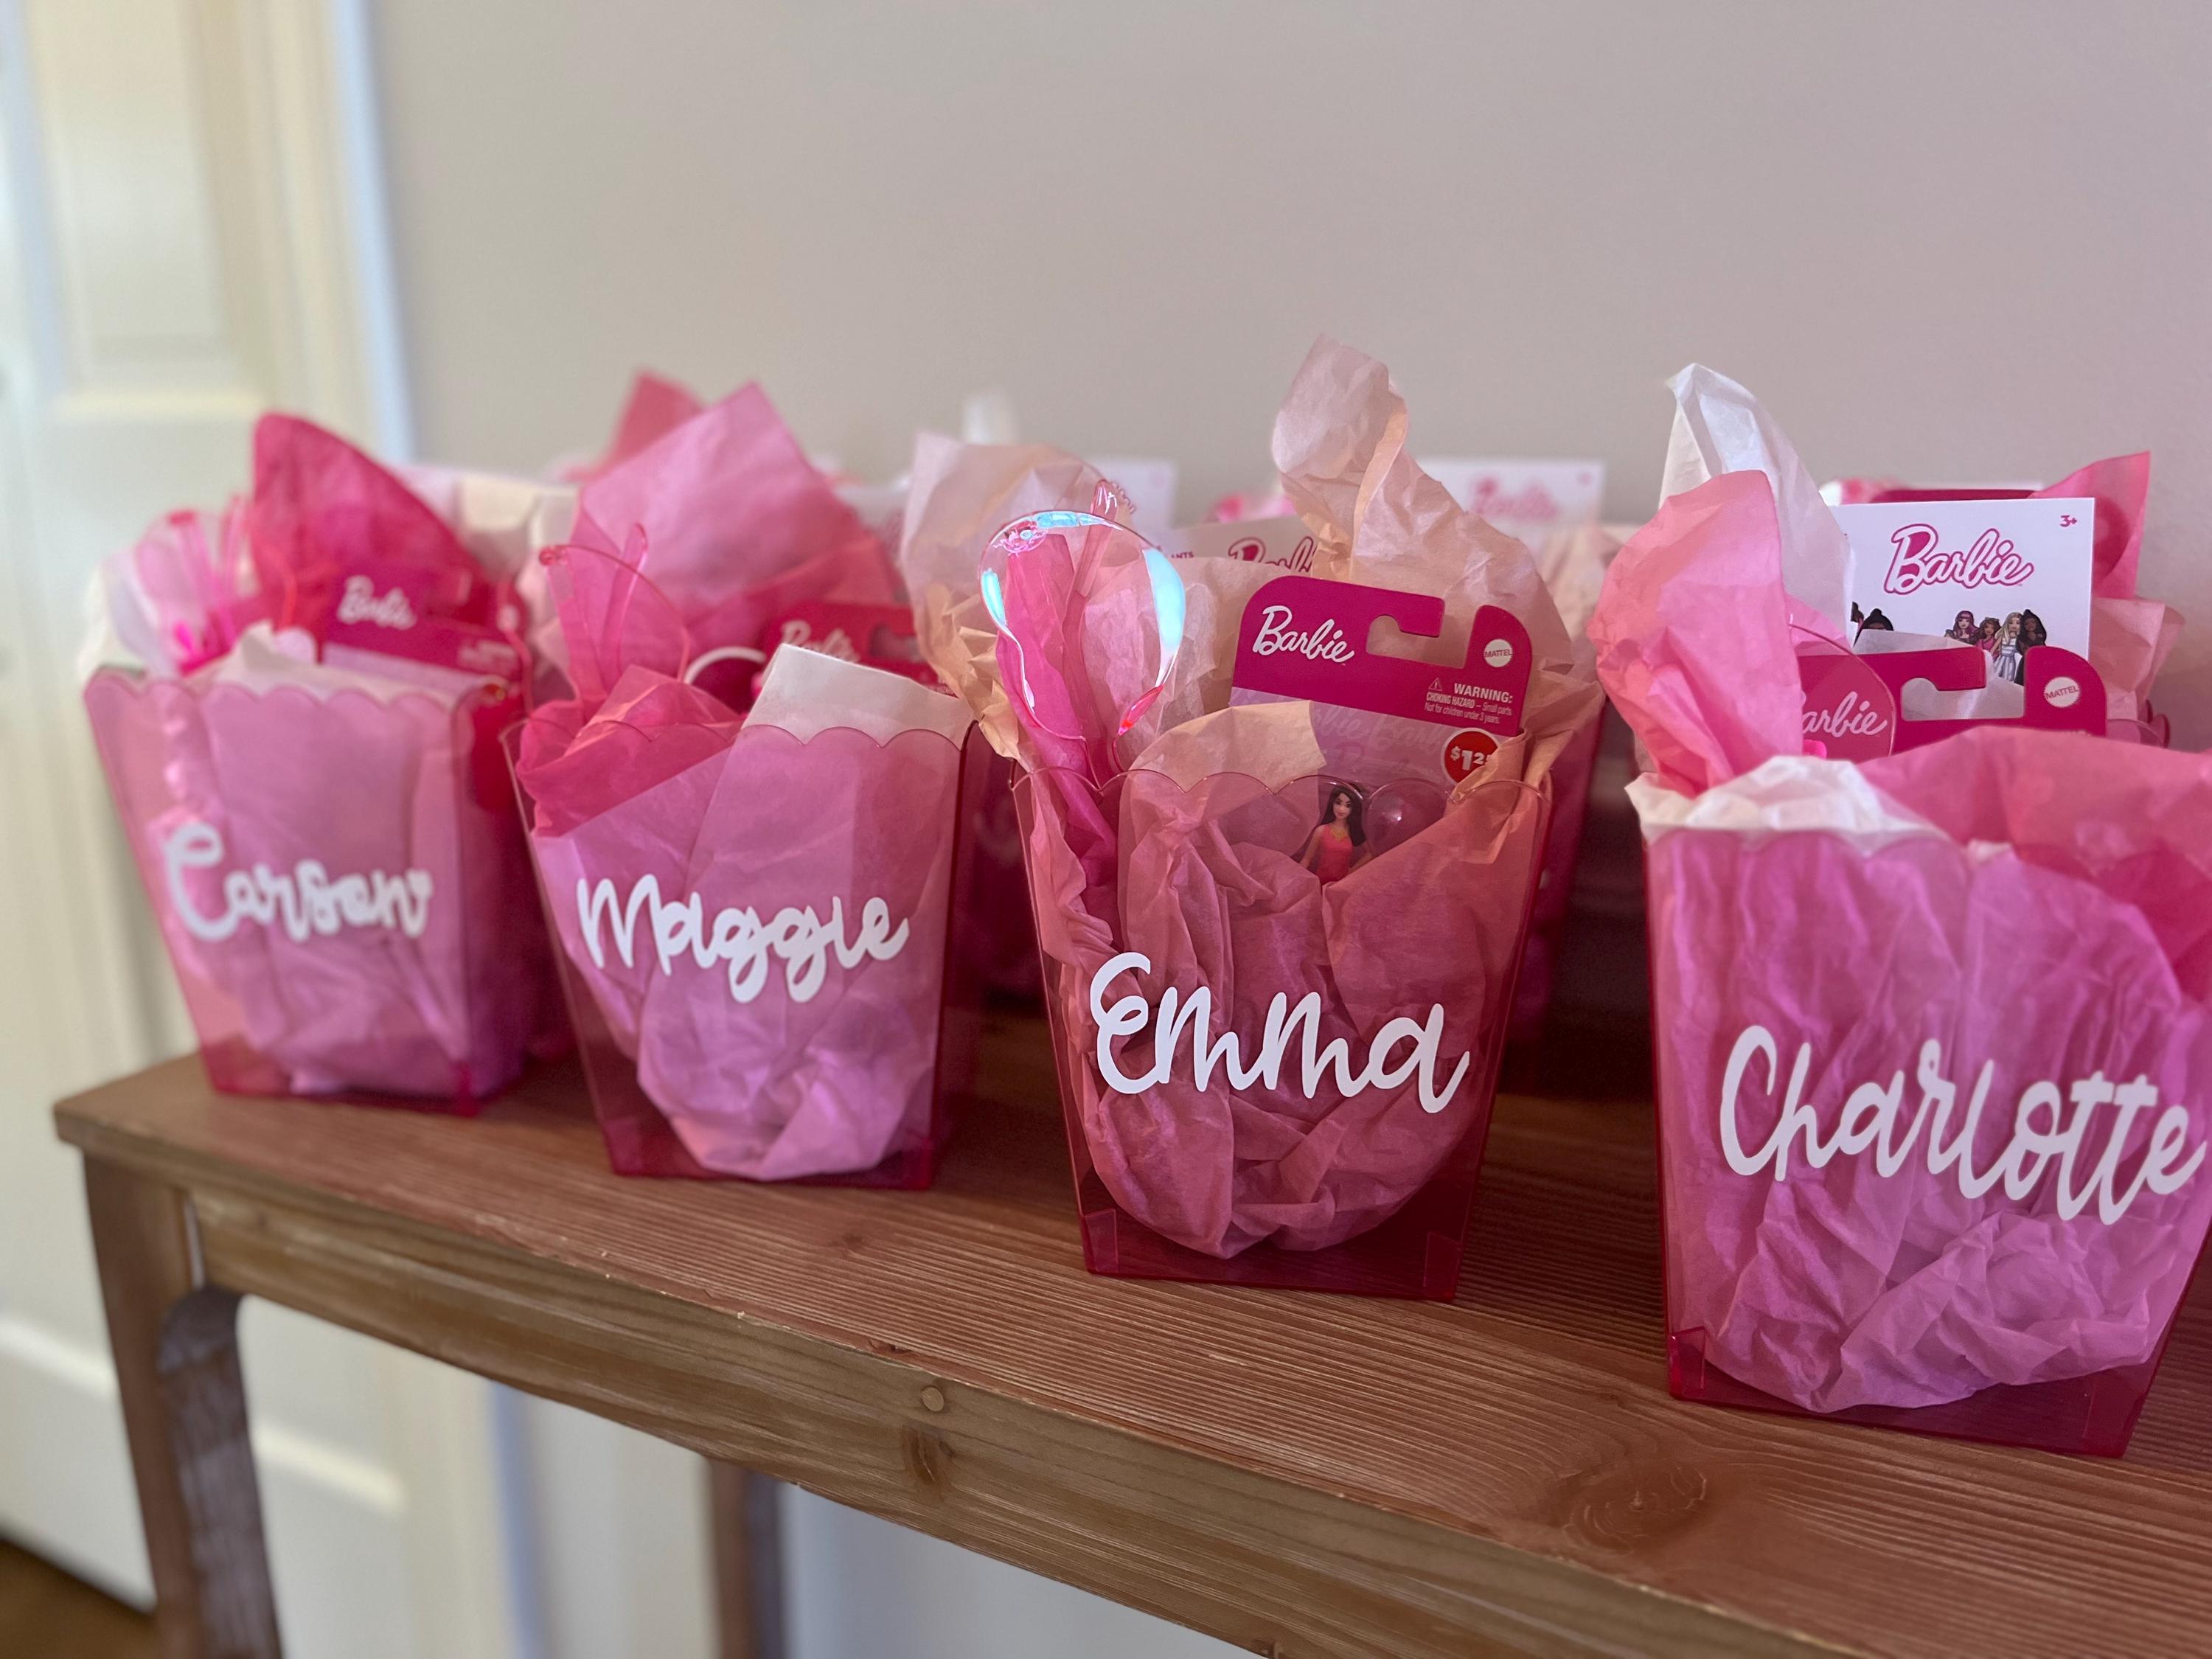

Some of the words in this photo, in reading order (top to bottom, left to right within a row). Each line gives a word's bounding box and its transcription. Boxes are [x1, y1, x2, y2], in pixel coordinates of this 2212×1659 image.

[2059, 515, 2077, 528] 3+
[1884, 523, 2034, 595] Barbie
[1252, 605, 1354, 663] Barbie
[1484, 650, 1513, 658] MATTEL
[1426, 692, 1452, 705] CHOKING
[1451, 695, 1475, 709] HAZARD
[1454, 683, 1514, 704] WARNING:
[1799, 690, 1888, 737] arbie
[2045, 685, 2080, 699] MATTEL
[577, 874, 909, 1003] Maggie
[1090, 952, 1470, 1113] Emma
[1719, 1025, 2208, 1225] Charlotte
